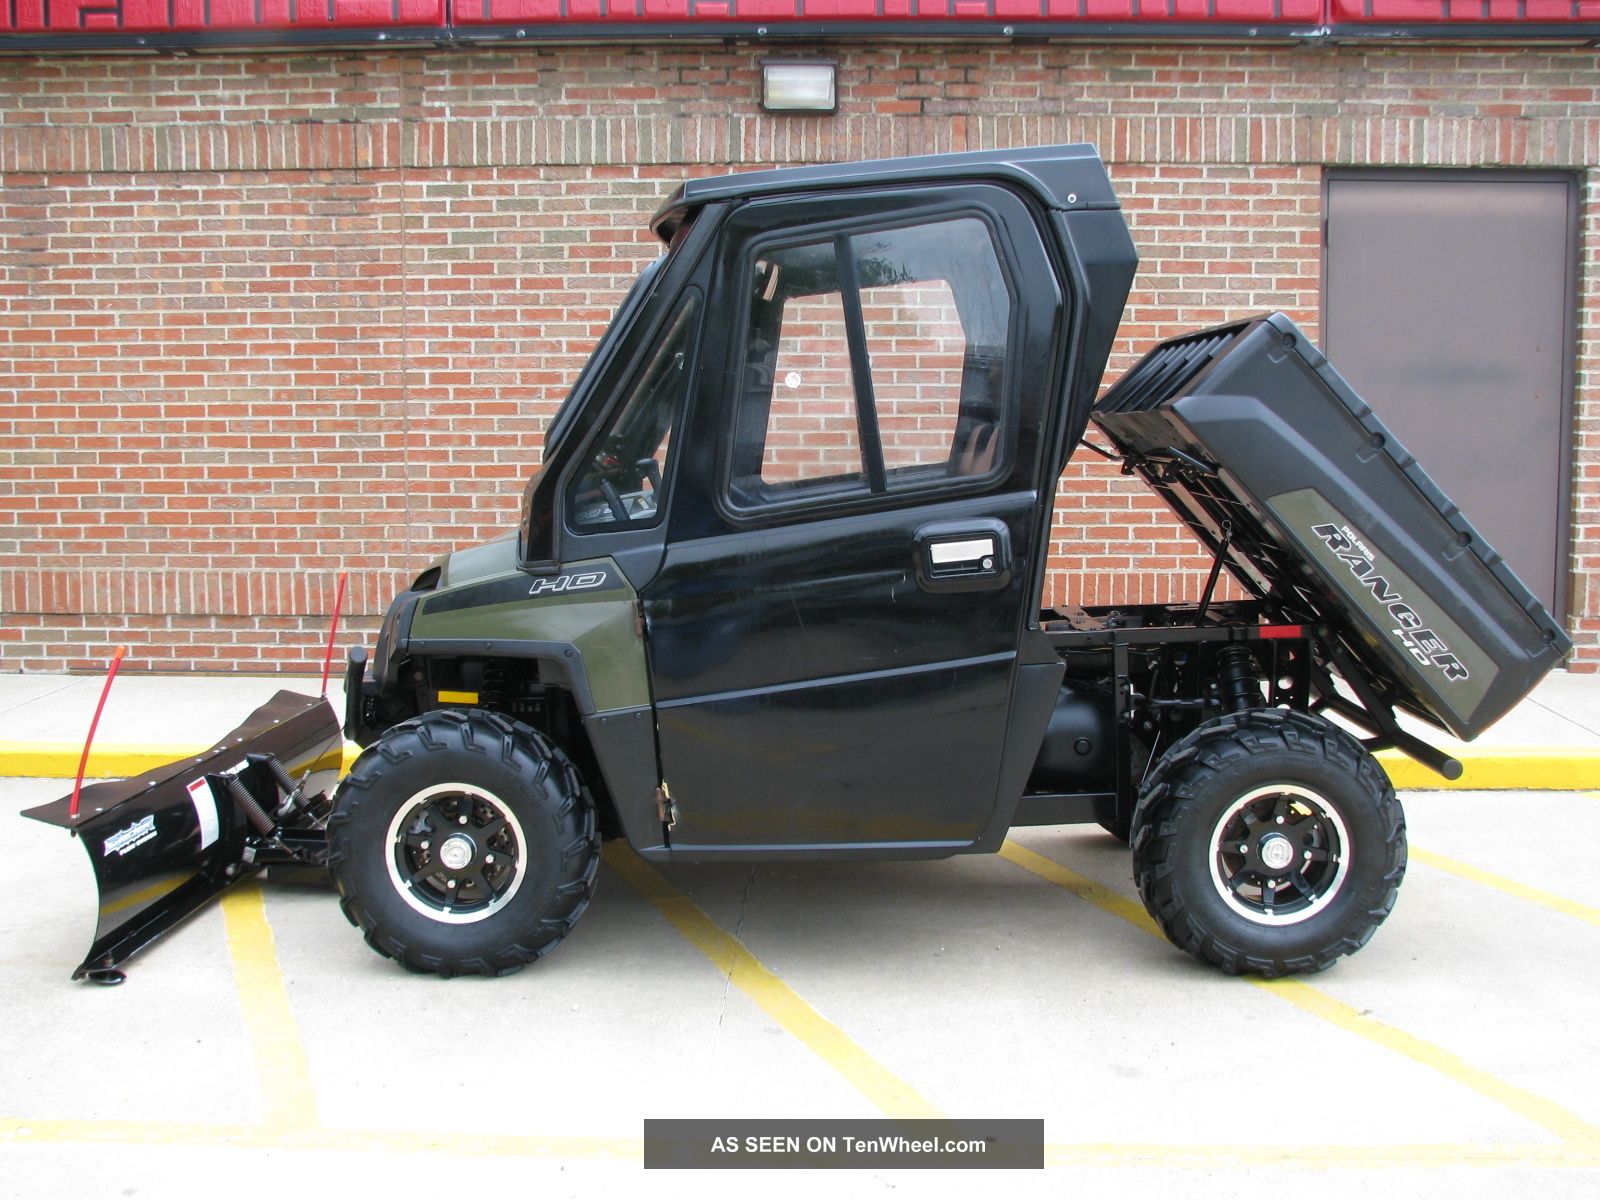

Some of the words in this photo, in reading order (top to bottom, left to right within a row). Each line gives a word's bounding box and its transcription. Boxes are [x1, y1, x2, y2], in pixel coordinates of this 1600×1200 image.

[1341, 525, 1376, 562] POLARIS
[529, 571, 607, 595] HD
[1311, 523, 1469, 681] RANGER
[1392, 628, 1431, 666] HD
